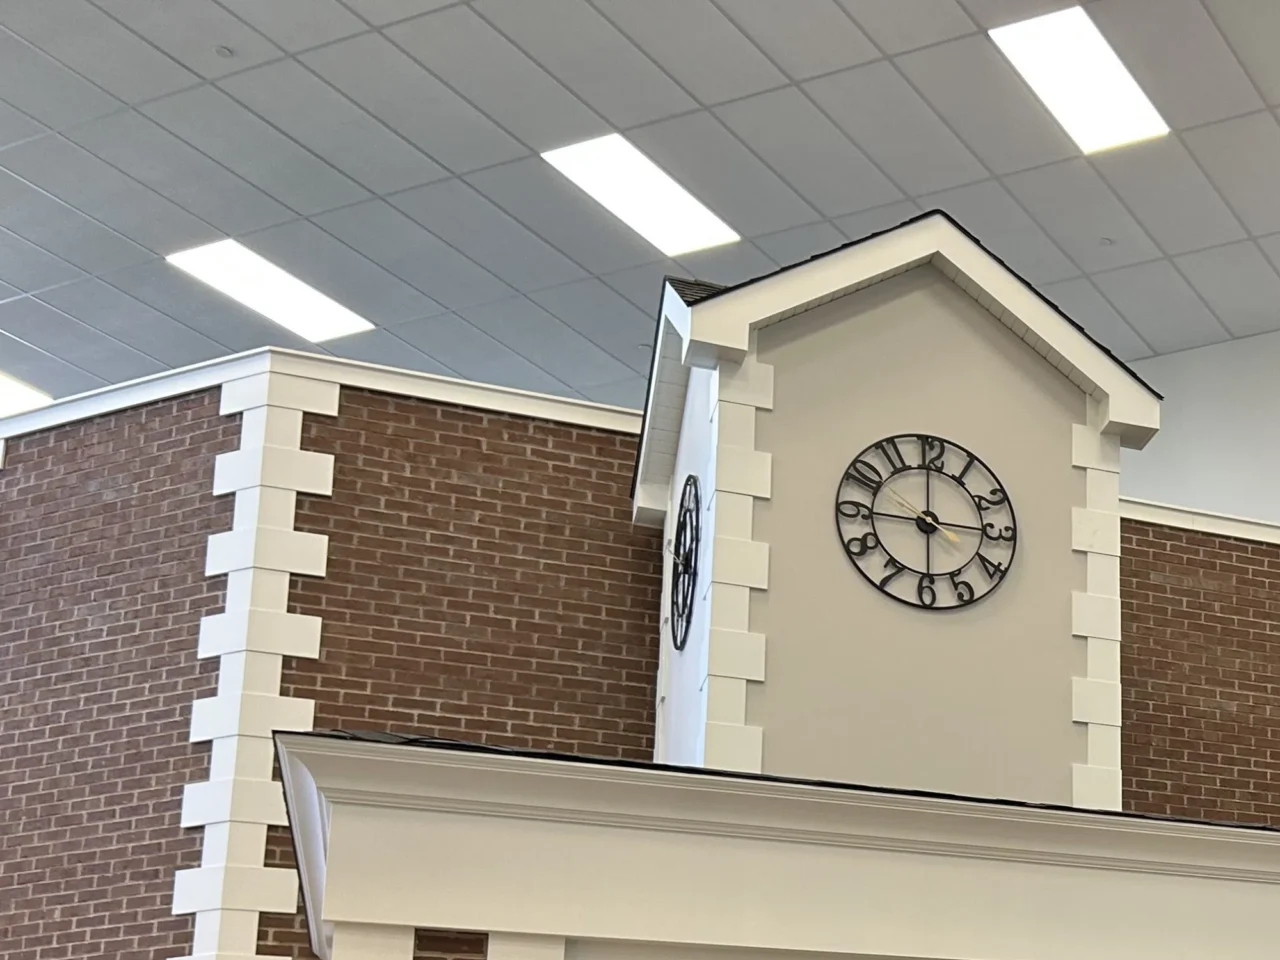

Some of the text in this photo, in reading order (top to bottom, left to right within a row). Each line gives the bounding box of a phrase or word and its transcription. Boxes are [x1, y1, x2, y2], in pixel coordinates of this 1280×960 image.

[875, 438, 912, 475] 11
[917, 435, 946, 472] 12
[952, 452, 976, 487] 1
[845, 459, 885, 496] 10
[838, 501, 873, 520] 9
[972, 488, 1007, 511] 2
[846, 532, 879, 556] 8
[982, 522, 1016, 542] 3
[879, 557, 906, 589] 7
[976, 550, 1008, 580] 4
[917, 575, 937, 607] 6
[949, 568, 975, 603] 5
